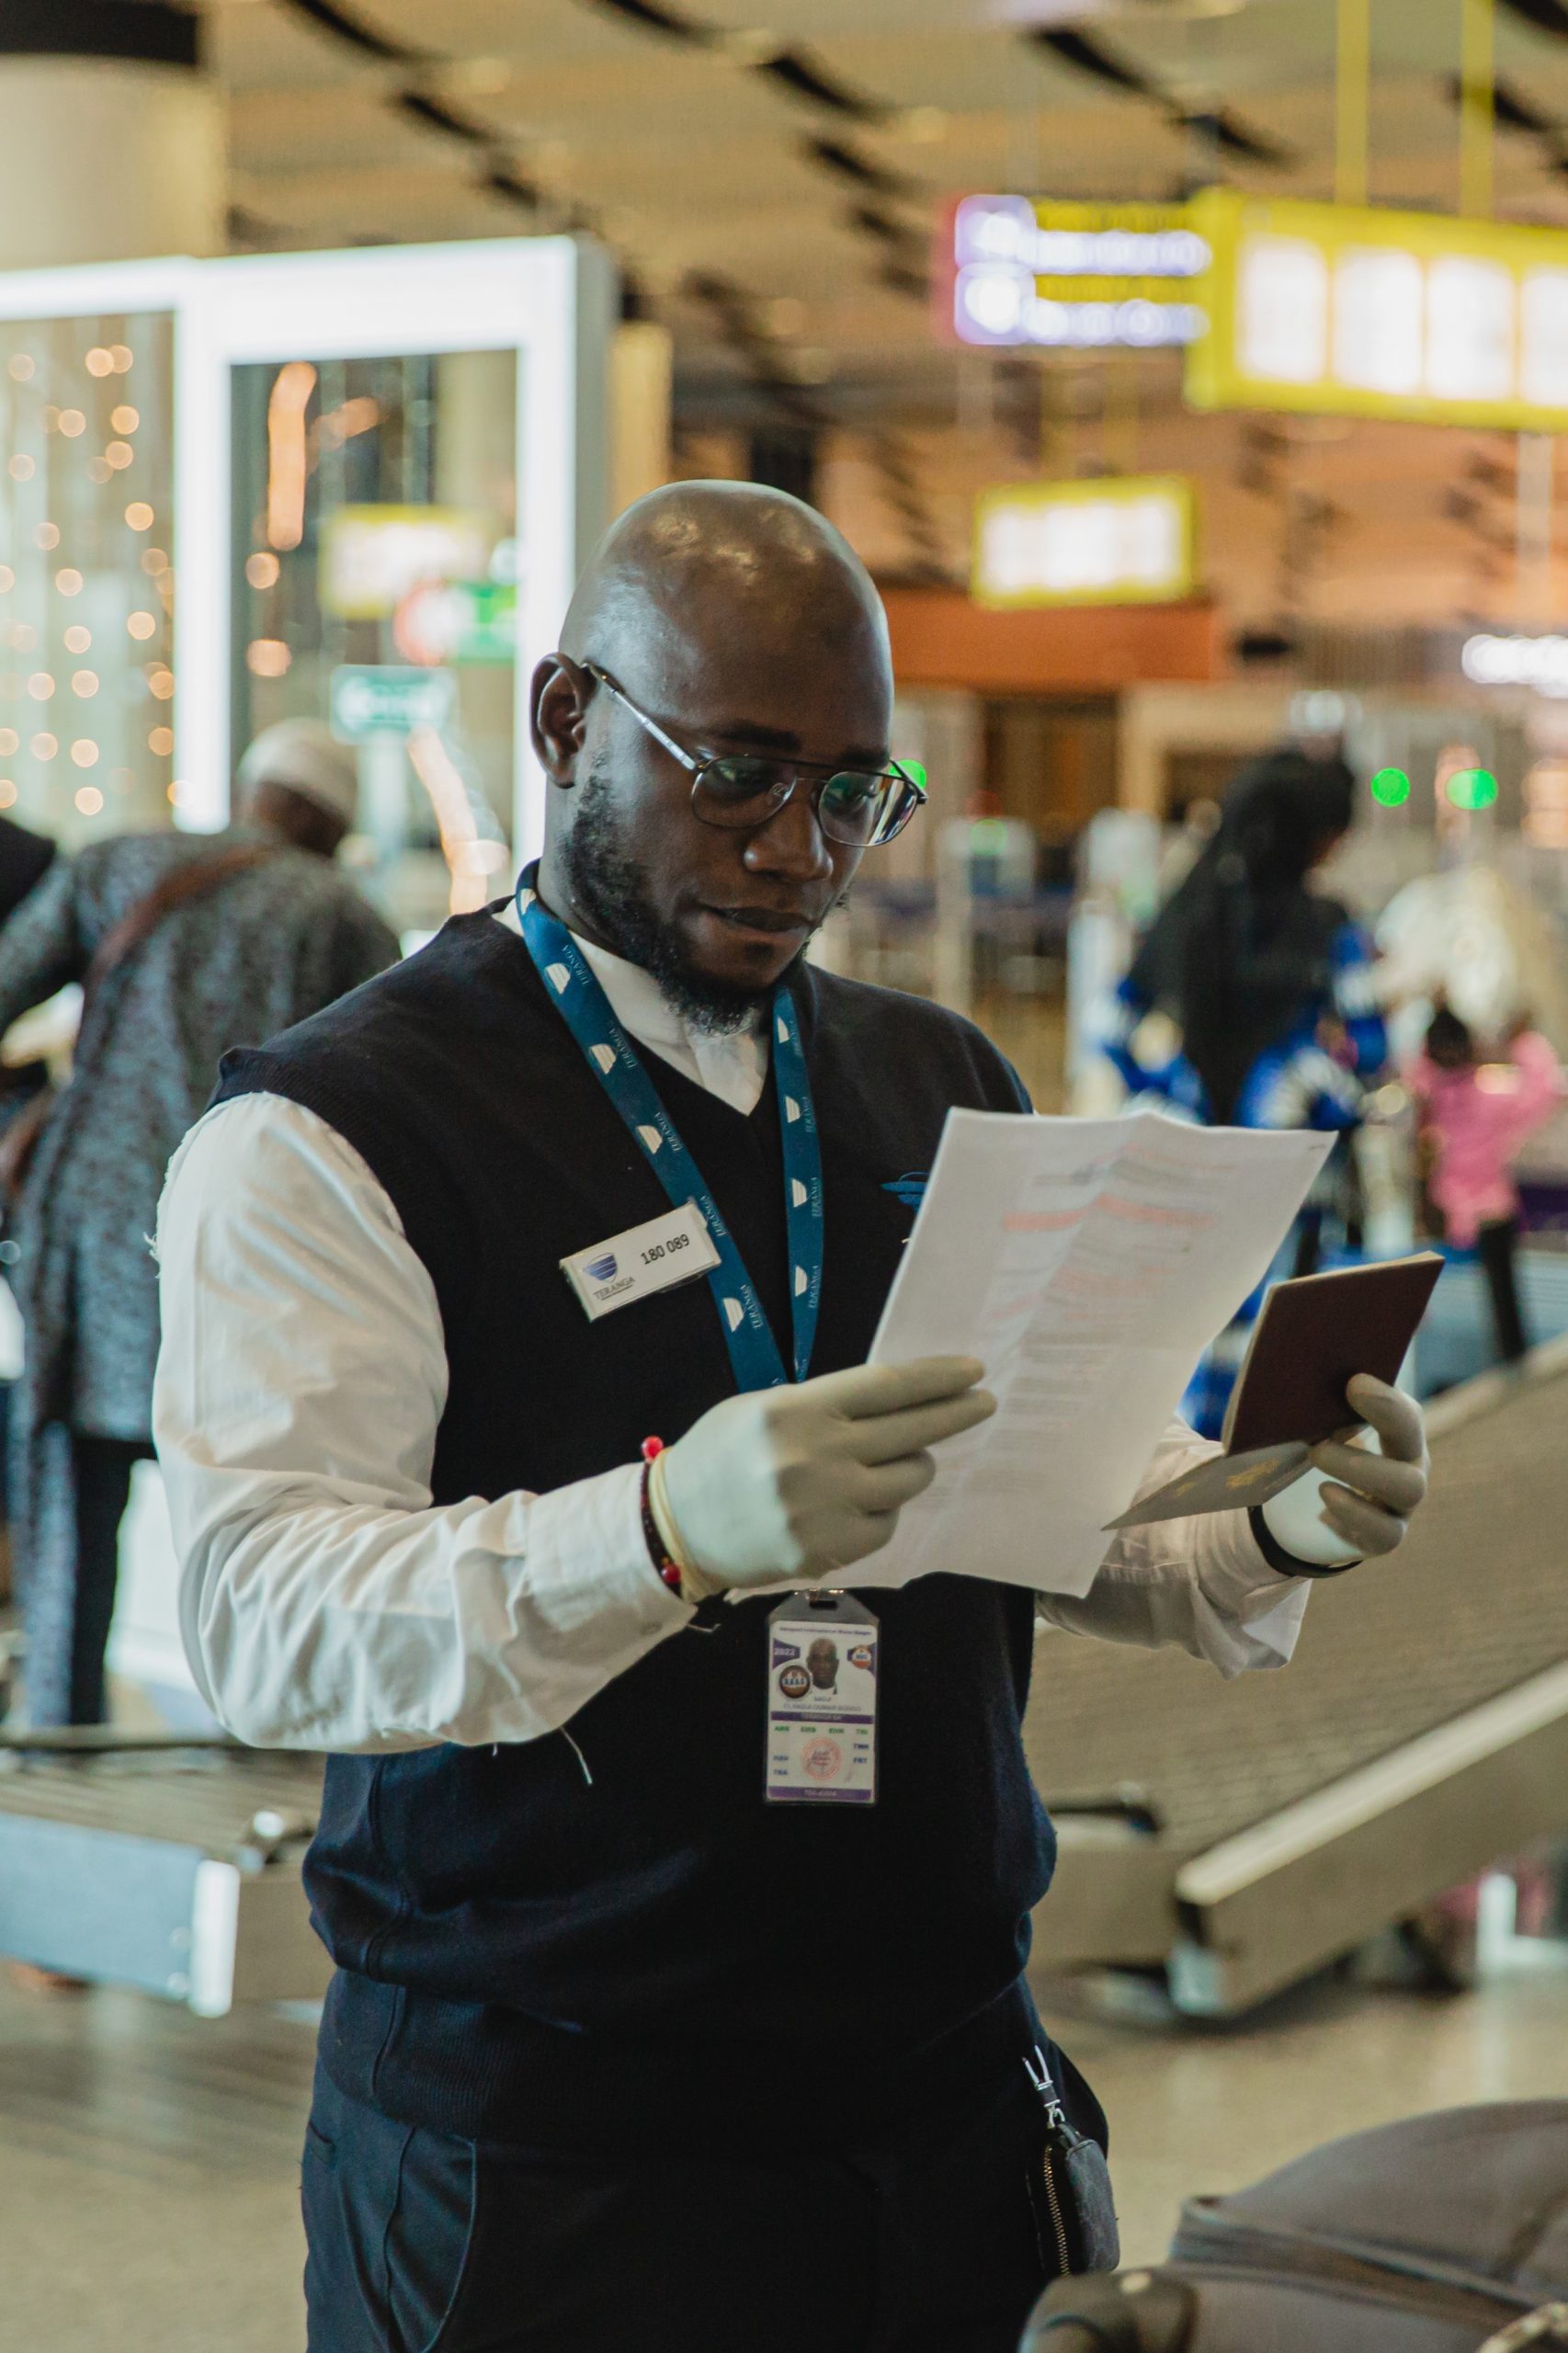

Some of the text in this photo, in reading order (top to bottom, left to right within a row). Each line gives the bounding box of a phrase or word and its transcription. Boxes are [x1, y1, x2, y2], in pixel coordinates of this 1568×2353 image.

[640, 1233, 690, 1266] 180 089
[593, 1276, 635, 1300] TERANGA
